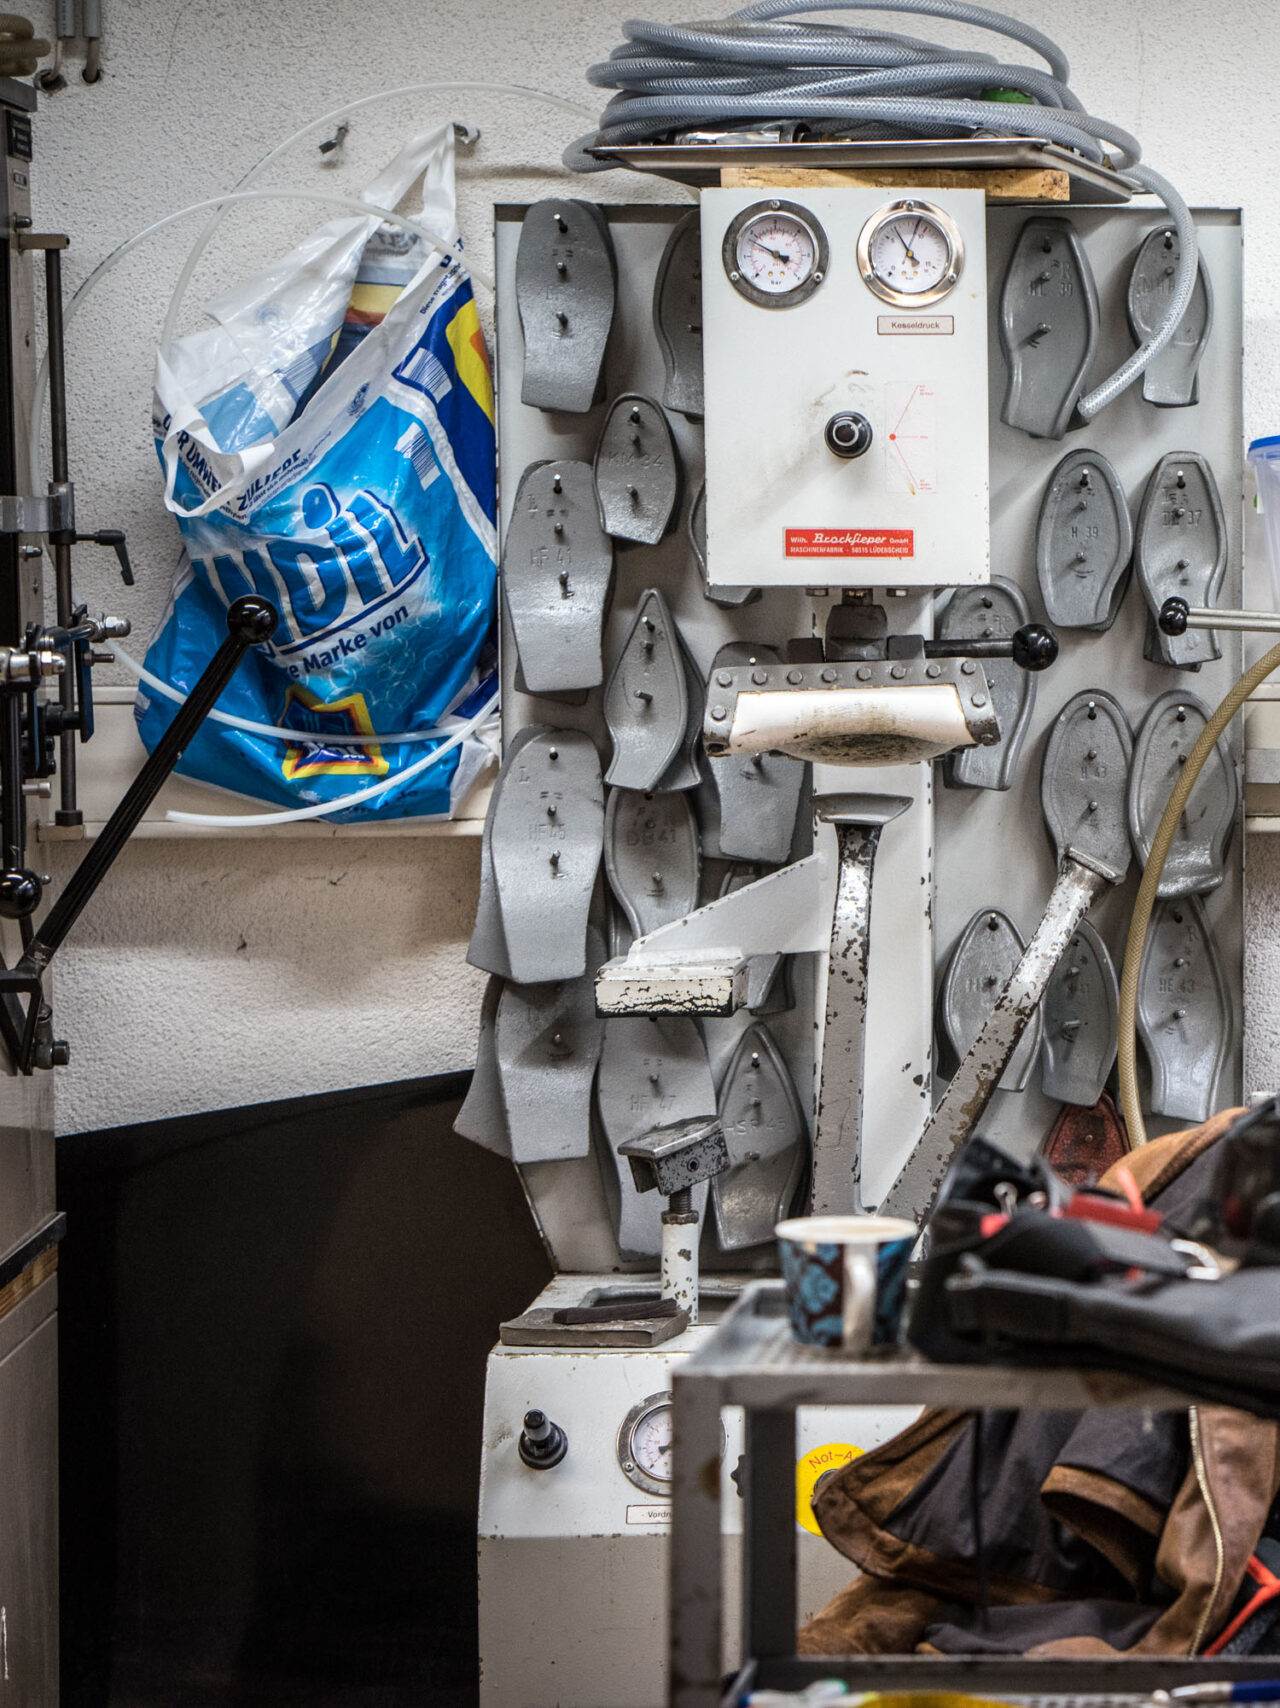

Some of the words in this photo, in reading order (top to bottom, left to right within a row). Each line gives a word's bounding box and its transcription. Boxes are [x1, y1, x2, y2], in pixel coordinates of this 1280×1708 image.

[891, 321, 940, 330] Kesseldruck
[790, 536, 808, 544] Wilh.
[869, 545, 909, 553] LÜDENSCHEID
[303, 632, 367, 674] Marke
[369, 604, 410, 639] von
